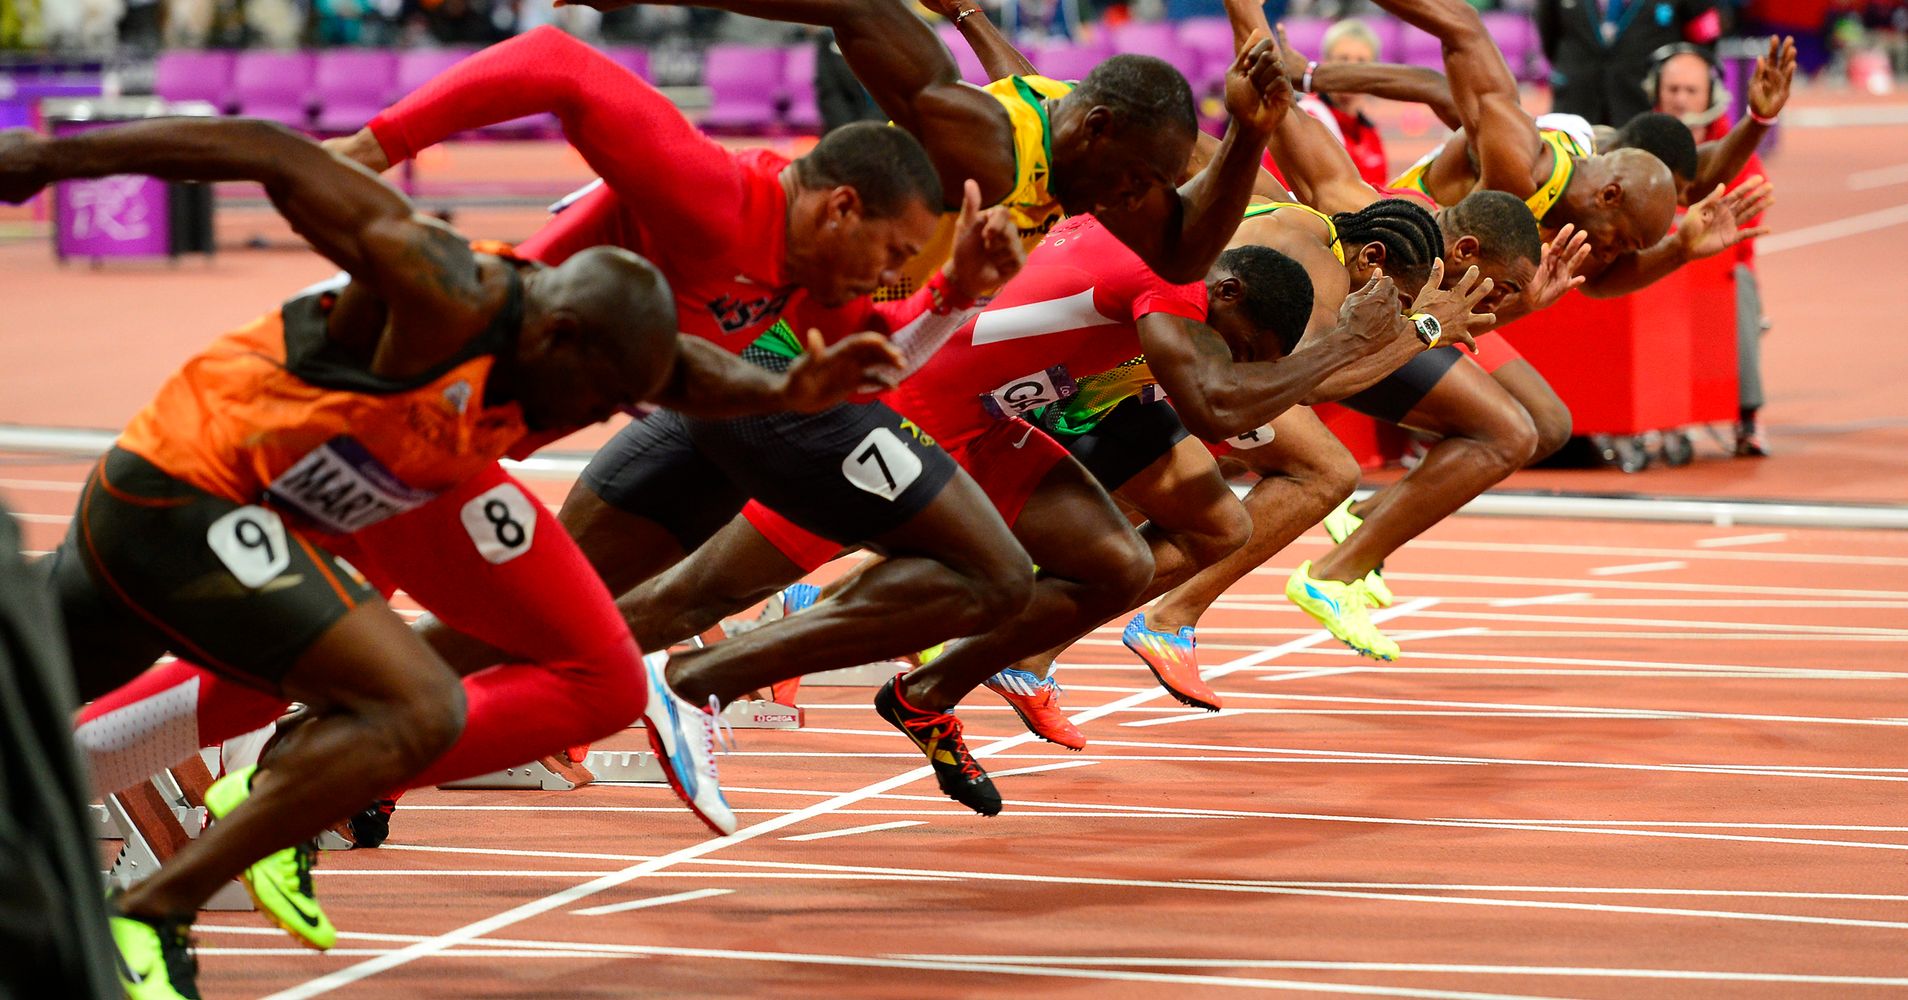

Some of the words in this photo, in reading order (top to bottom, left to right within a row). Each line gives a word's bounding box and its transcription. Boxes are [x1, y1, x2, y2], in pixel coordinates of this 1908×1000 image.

[856, 442, 897, 492] 7
[235, 519, 275, 564] 9
[484, 499, 525, 548] 8
